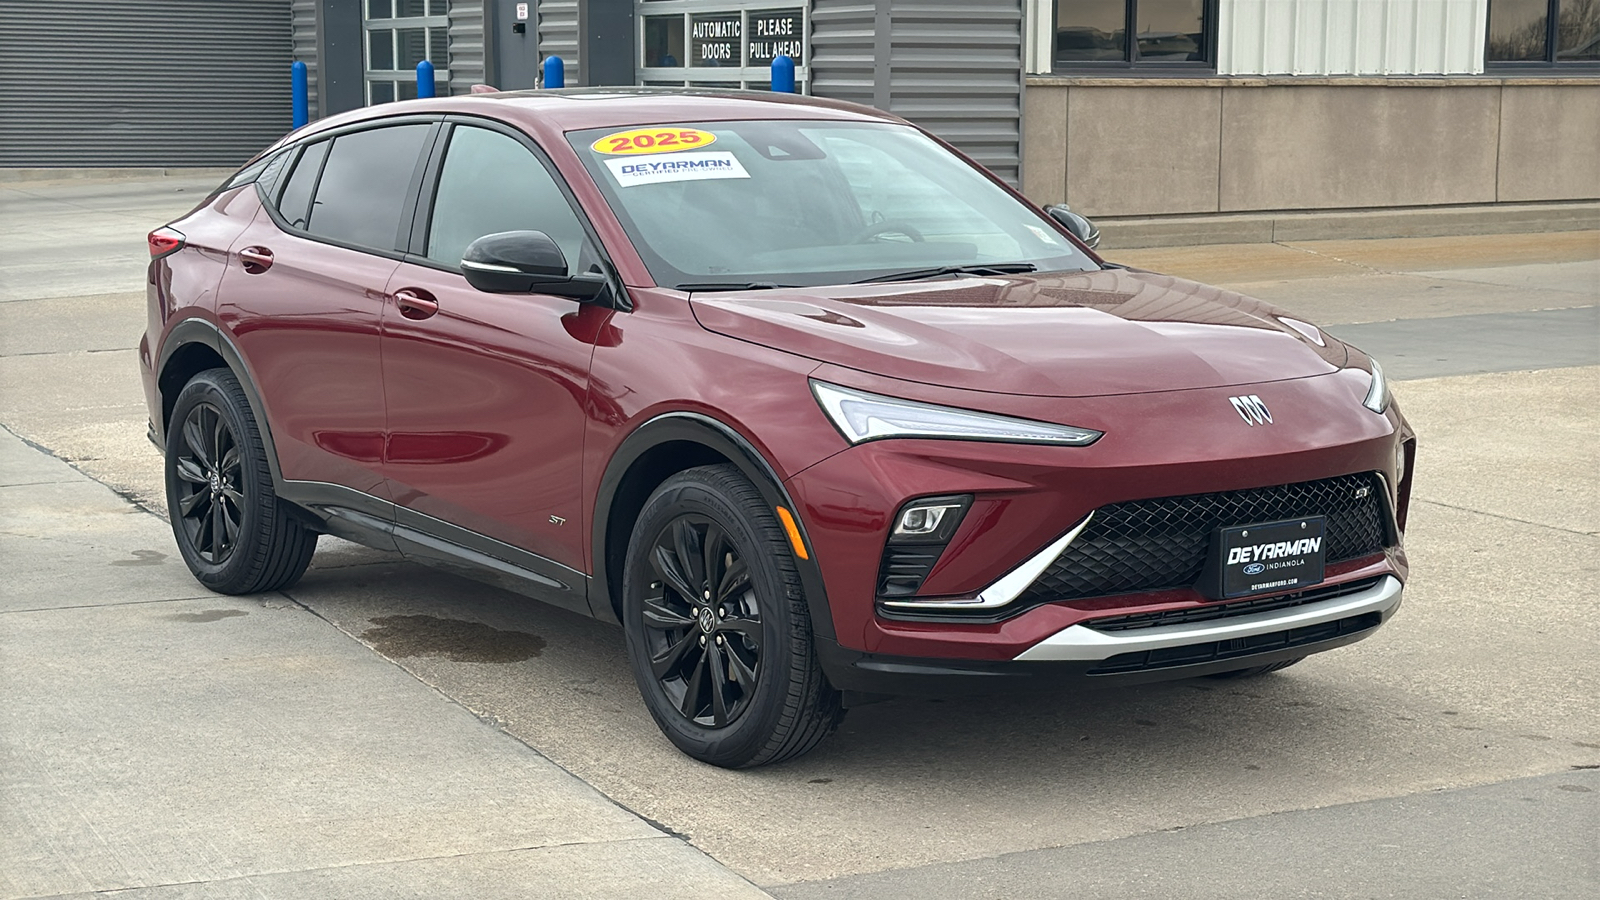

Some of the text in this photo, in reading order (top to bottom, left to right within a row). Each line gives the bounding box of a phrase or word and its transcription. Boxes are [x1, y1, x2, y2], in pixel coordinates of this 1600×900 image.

[692, 21, 741, 38] AUTOMATIC
[757, 18, 793, 36] PLEASE
[701, 43, 731, 59] DOORS
[749, 41, 801, 59] PULL AHEAD
[609, 131, 702, 152] 2025
[621, 159, 732, 174] DEYARMAN
[632, 168, 680, 177] CERTIFIED
[548, 515, 566, 526] ST
[1226, 536, 1322, 565] DEYARMAN
[1266, 559, 1305, 570] INDIANOLA
[1251, 578, 1298, 591] DEYARMANFORD.COM
